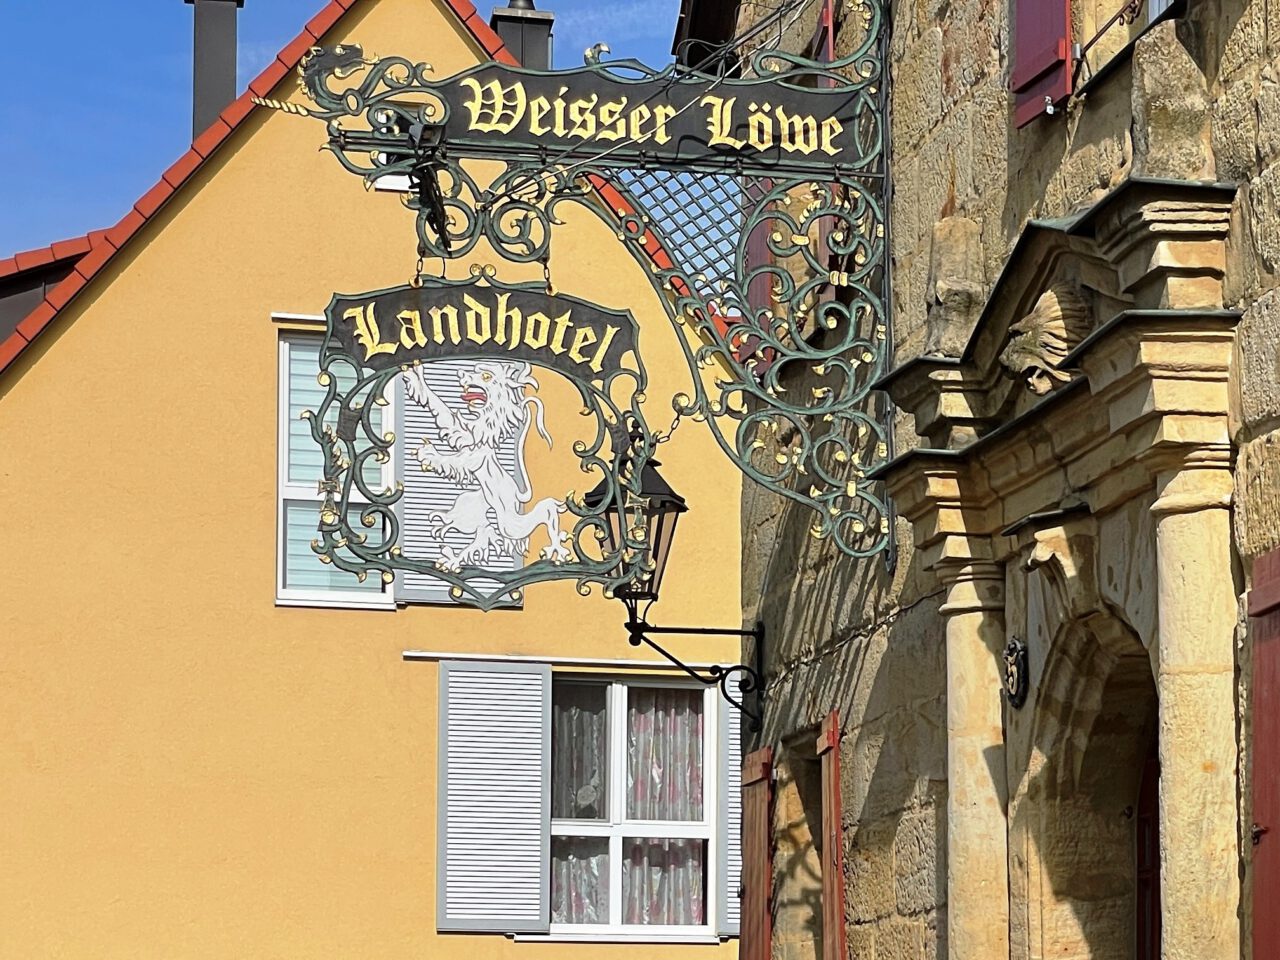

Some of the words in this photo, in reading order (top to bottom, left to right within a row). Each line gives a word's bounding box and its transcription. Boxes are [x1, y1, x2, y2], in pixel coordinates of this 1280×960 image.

[459, 77, 677, 145] Weisser
[700, 95, 844, 156] Löwe
[343, 292, 621, 373] Landhotel
